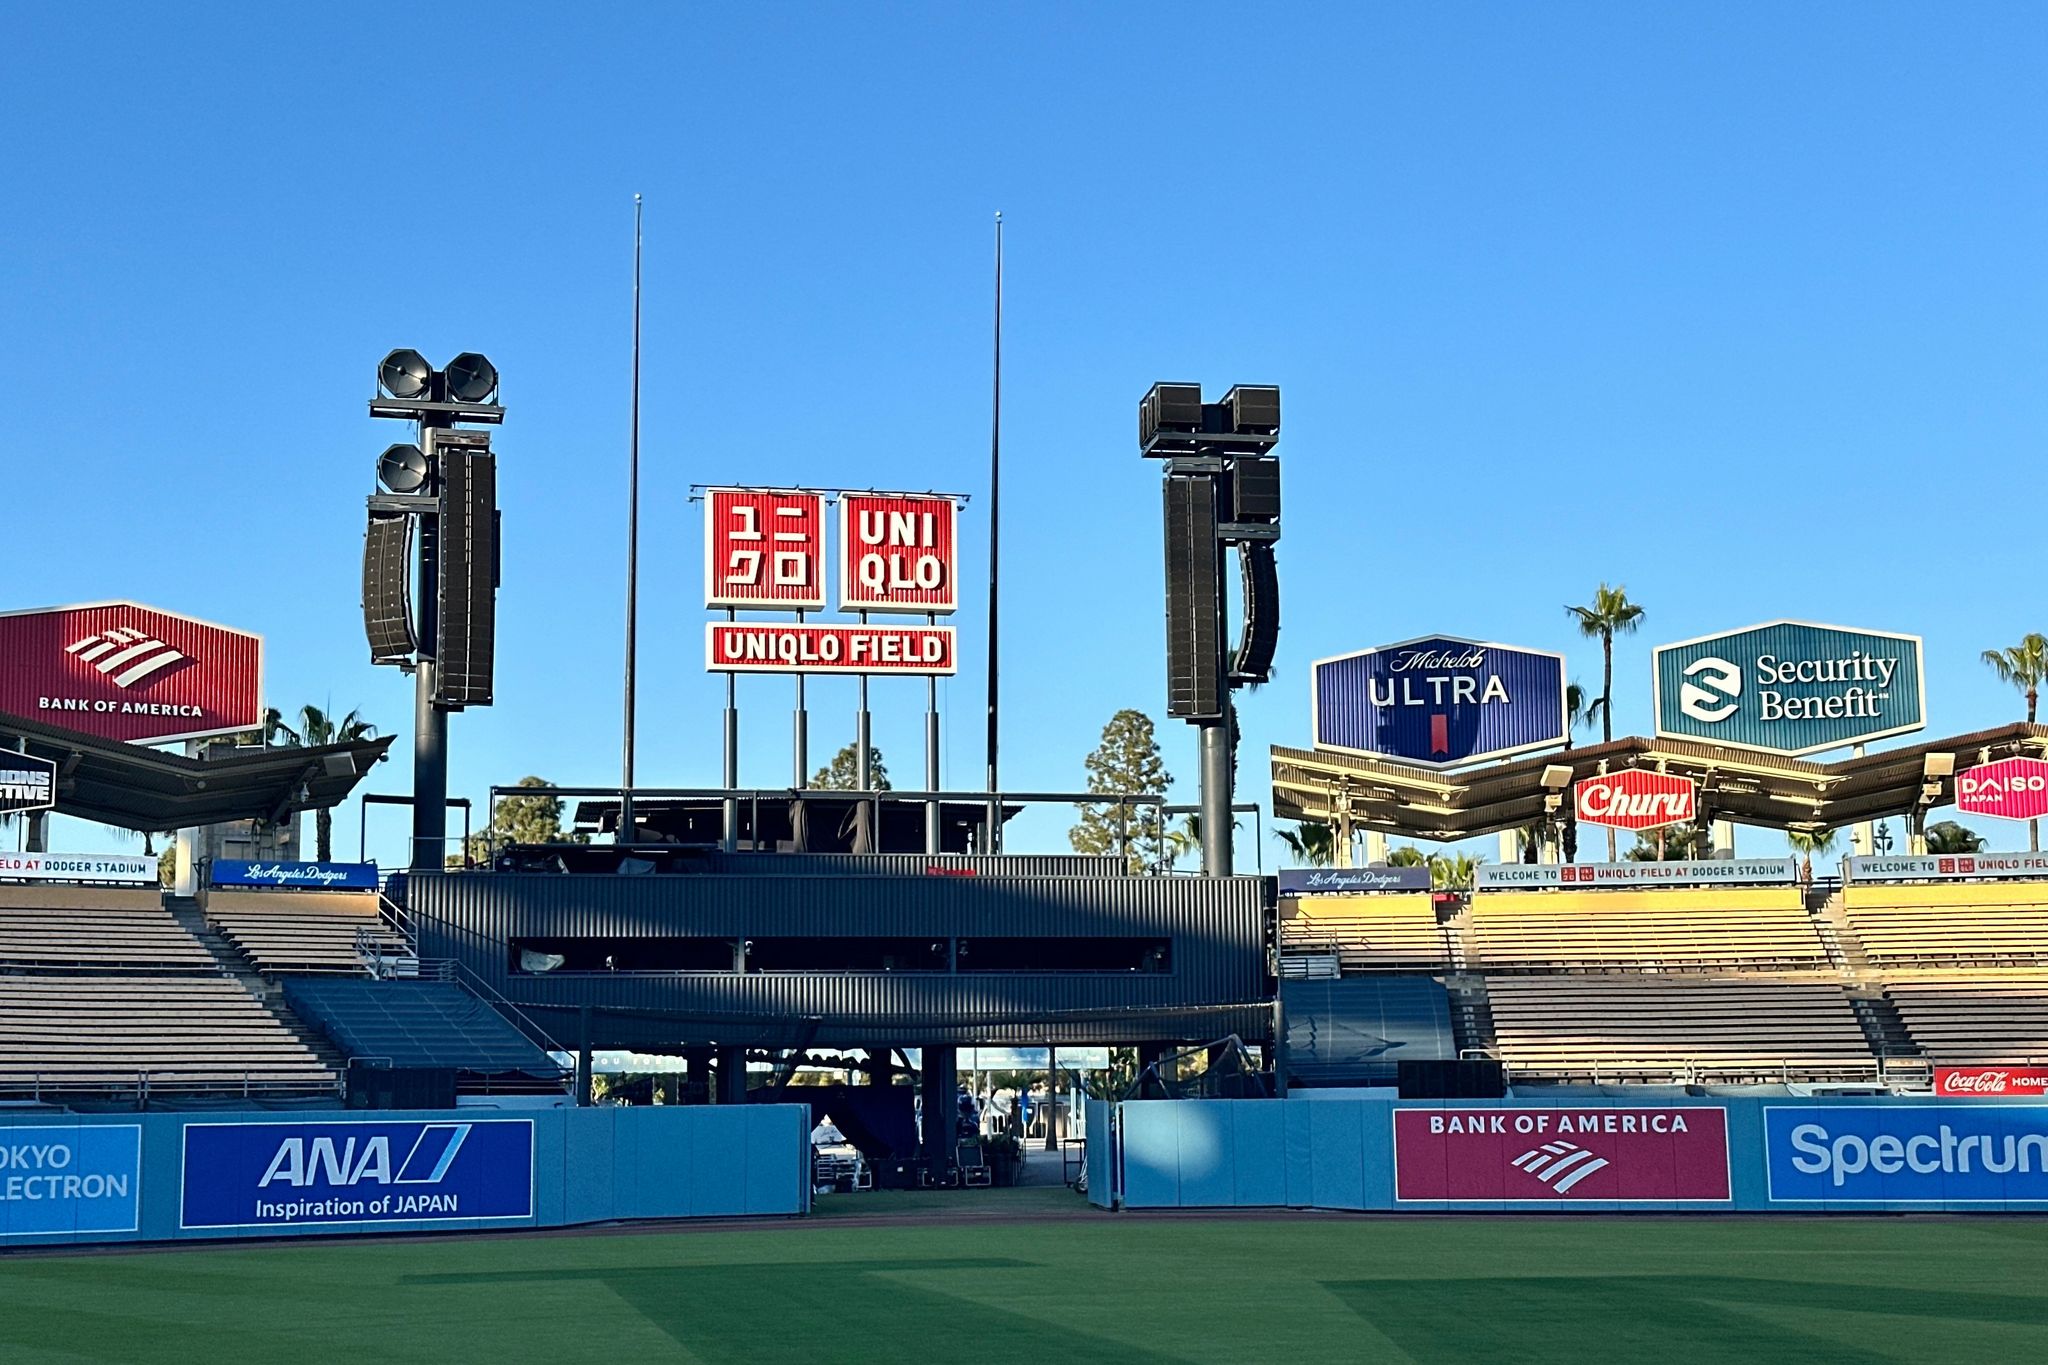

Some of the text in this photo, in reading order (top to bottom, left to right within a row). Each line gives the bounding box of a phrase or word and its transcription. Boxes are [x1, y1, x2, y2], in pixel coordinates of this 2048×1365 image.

[729, 505, 807, 541] ユニ
[860, 510, 933, 547] UNI
[860, 553, 941, 594] QLO
[724, 631, 942, 665] UNIQLO FIELD
[1389, 649, 1487, 673] Michelob
[1757, 651, 1898, 688] Security
[1369, 674, 1511, 707] ULTRA
[39, 696, 203, 717] BANK OF AMERICA
[1759, 687, 1882, 721] Benefit
[1961, 775, 2045, 794] DAISO
[1963, 794, 2003, 803] JAPAN
[25, 860, 40, 870] AT
[44, 860, 92, 872] DODGER
[95, 861, 147, 873] STADIUM
[244, 864, 348, 885] Los Angeles Dodgers
[1488, 870, 1557, 880] WELCOME TO
[1597, 865, 1785, 879] UNIQLO FIELD AT DODGER STADIUM
[1861, 861, 1935, 873] WELCOME TO
[1978, 859, 2019, 871] UNIQLO
[1306, 871, 1401, 889] Los Angeles Dodgers
[1944, 1071, 2009, 1092] Coca-Cola
[1430, 1114, 1689, 1134] BANK OF AMERICA
[257, 1136, 391, 1187] ANA
[256, 1194, 458, 1220] Inspiration of JAPAN
